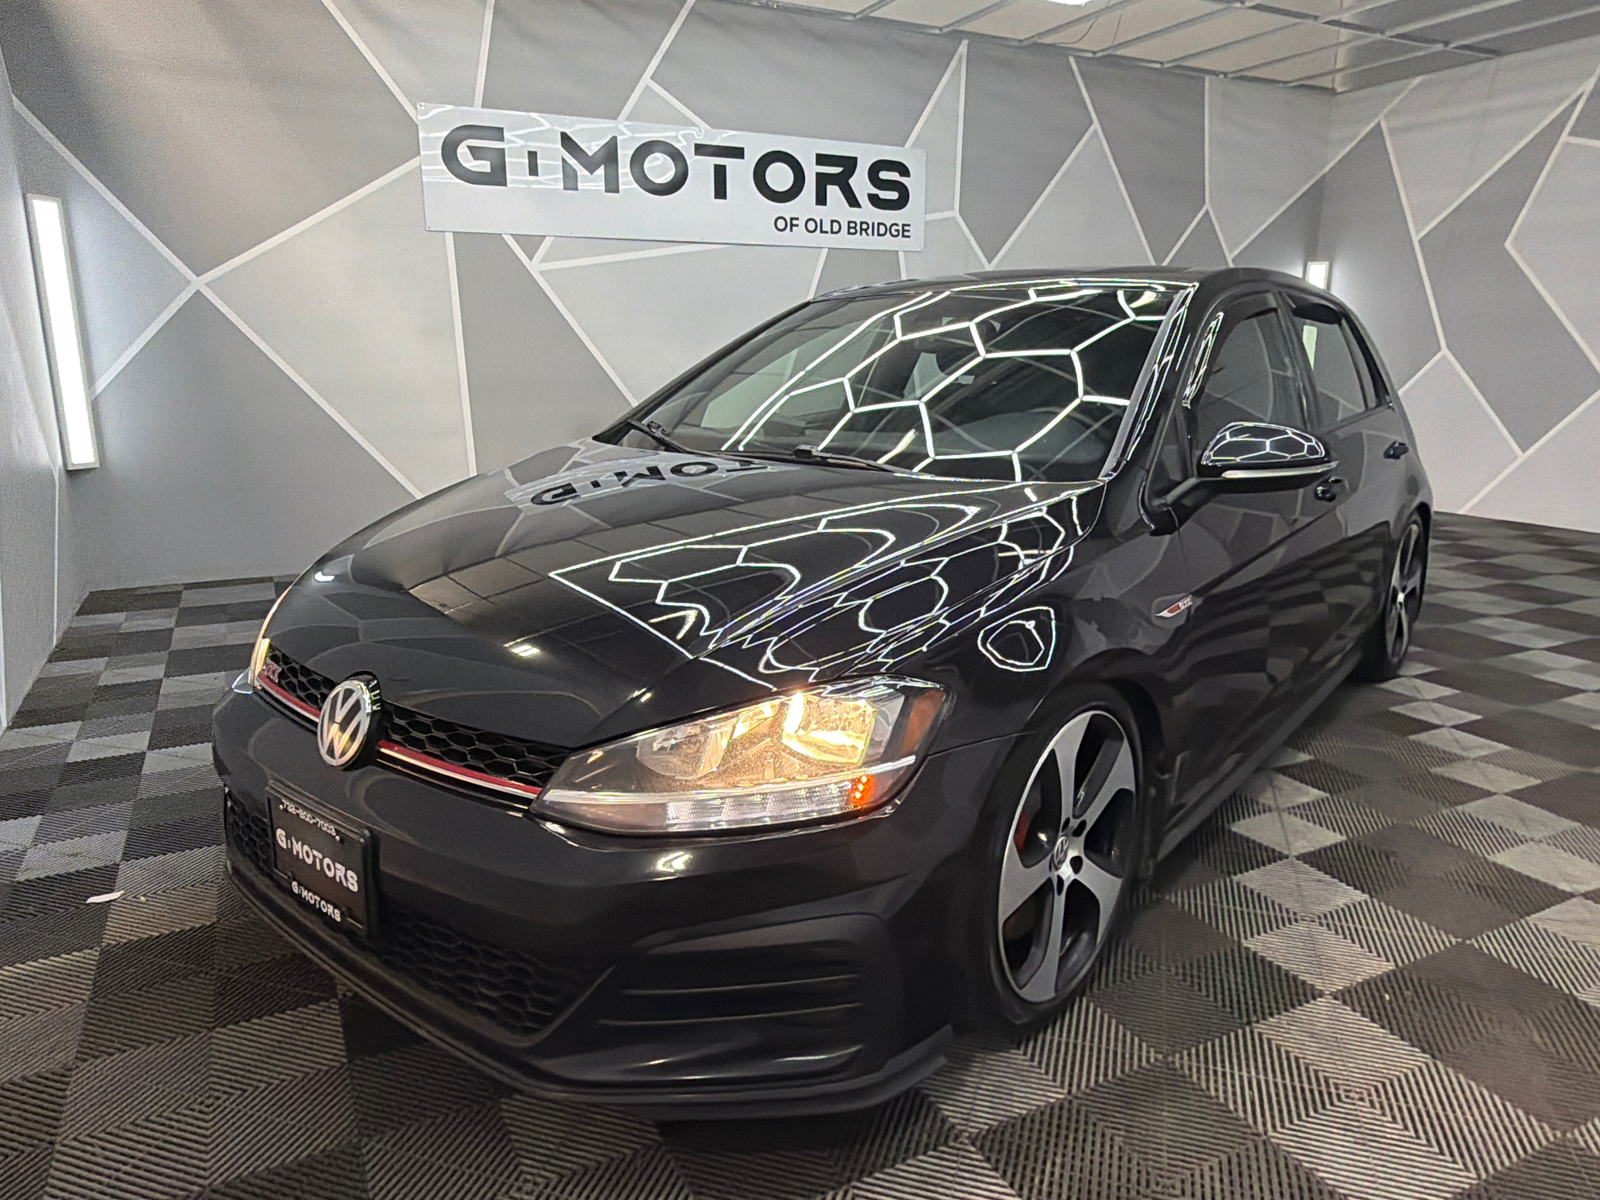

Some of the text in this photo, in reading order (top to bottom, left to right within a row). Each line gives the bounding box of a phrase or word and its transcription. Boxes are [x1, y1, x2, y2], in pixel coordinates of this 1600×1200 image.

[774, 216, 911, 238] OF OLD BRIDGE
